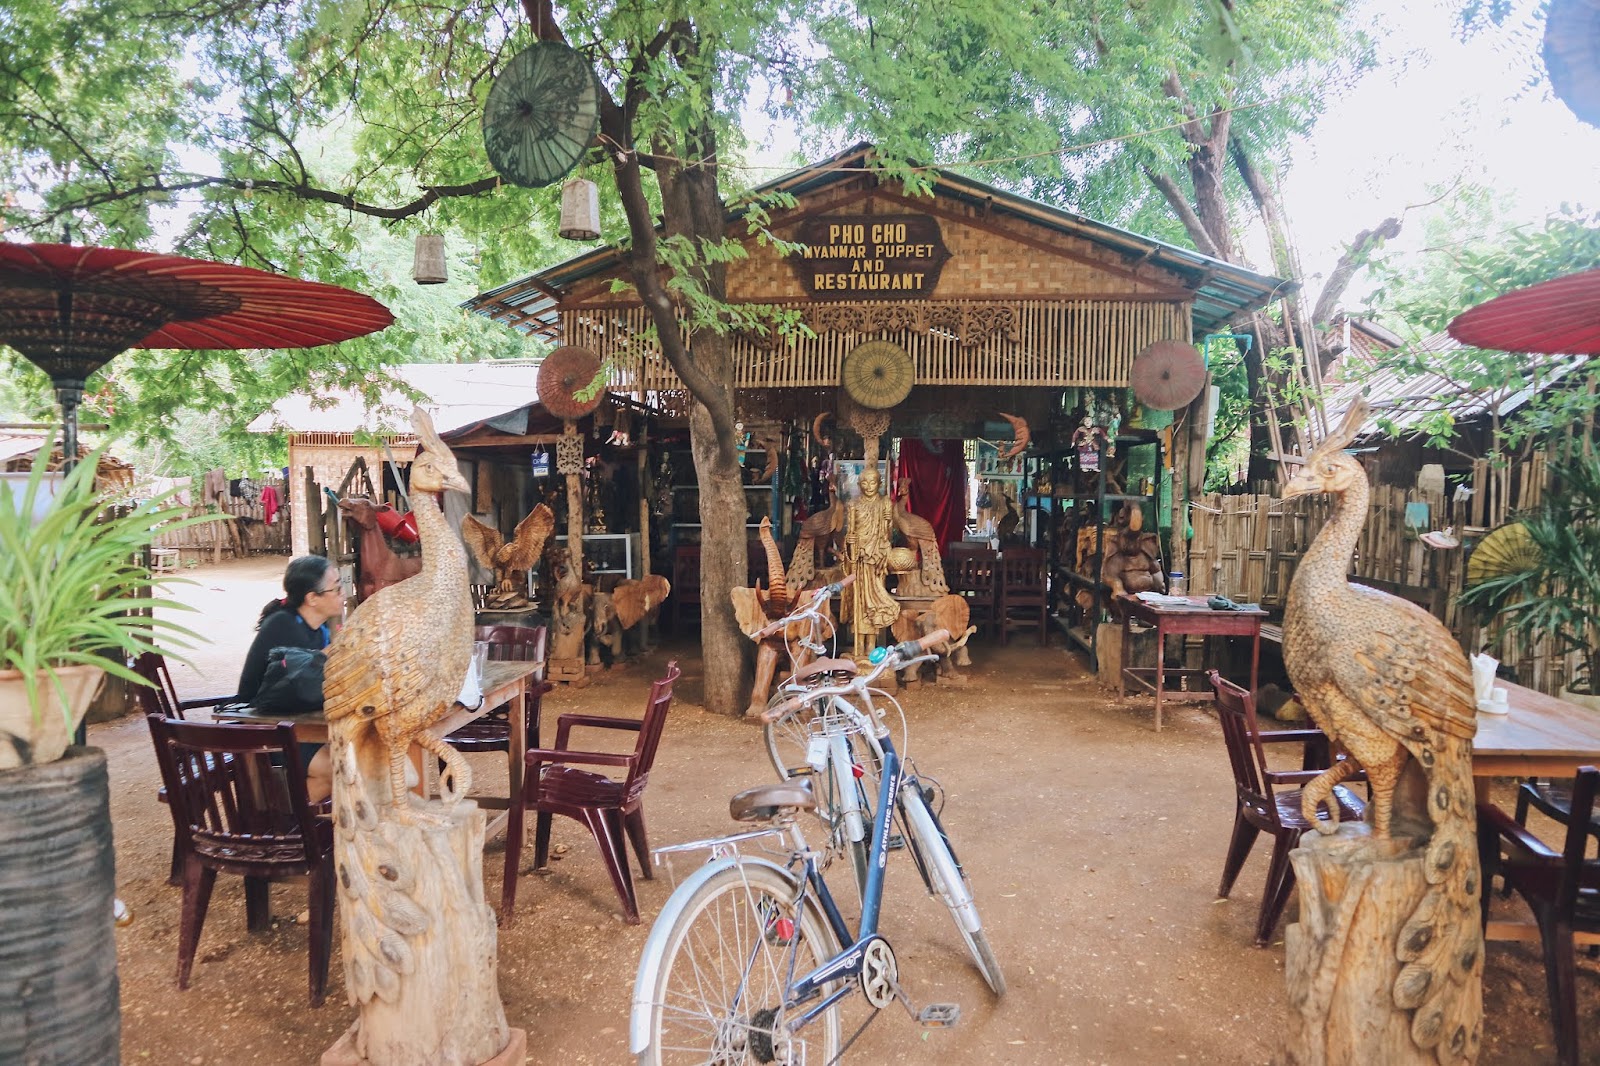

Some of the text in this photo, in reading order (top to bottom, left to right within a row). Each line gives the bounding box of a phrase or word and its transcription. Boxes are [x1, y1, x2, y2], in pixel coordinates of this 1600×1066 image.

[829, 223, 907, 245] PHO CHO
[803, 244, 934, 259] MYANMAR PUPPET
[852, 259, 885, 273] AND
[814, 273, 925, 290] RESTAURANT
[882, 809, 892, 850] ATHLETIC
